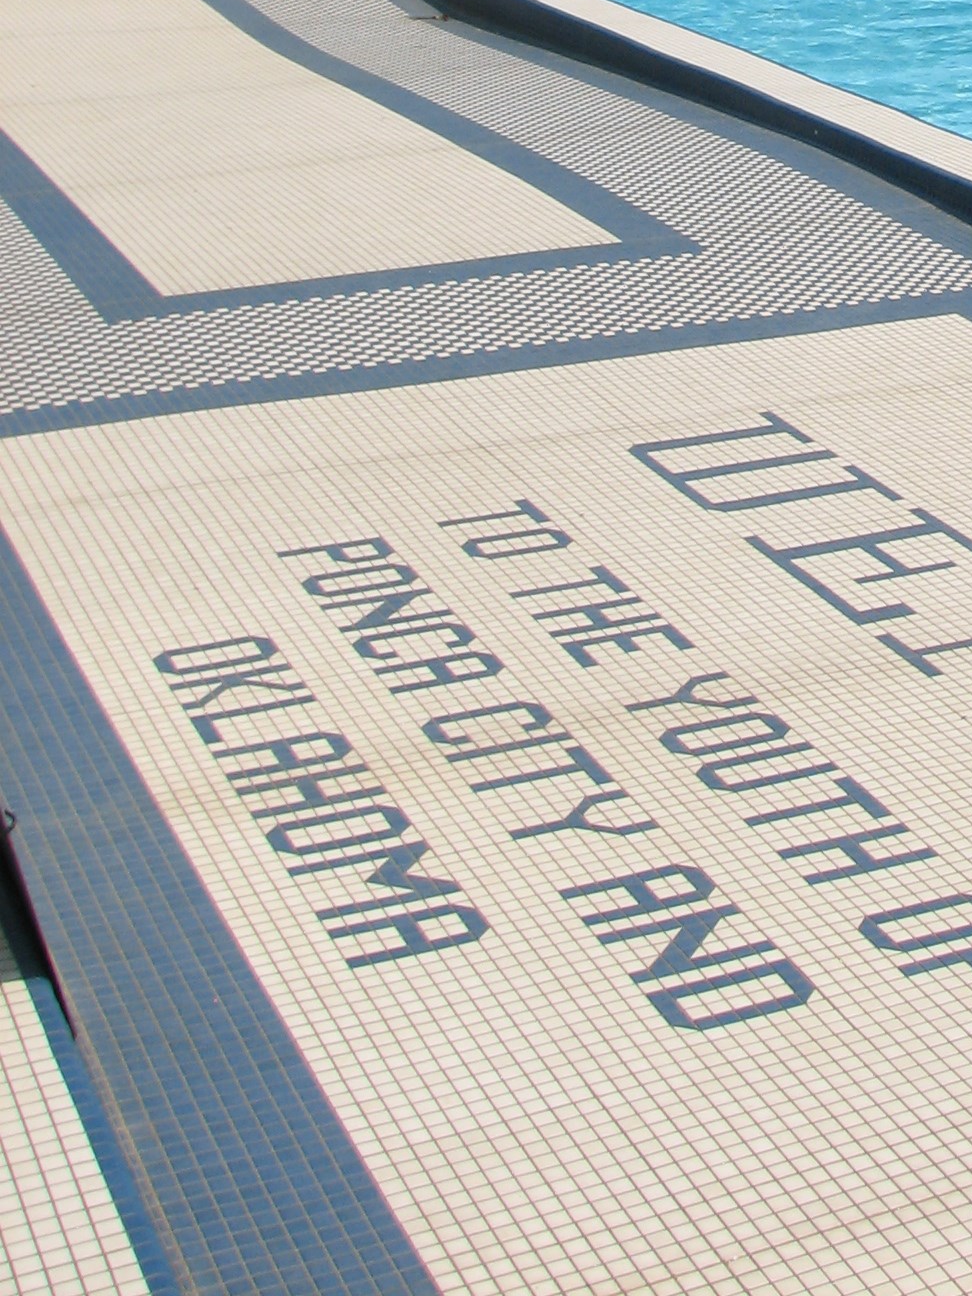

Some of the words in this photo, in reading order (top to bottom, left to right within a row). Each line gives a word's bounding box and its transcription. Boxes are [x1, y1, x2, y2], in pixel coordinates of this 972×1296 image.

[152, 635, 491, 970] OKLAHOMA
[277, 535, 505, 695] PONCA
[421, 701, 660, 840] CITY
[558, 864, 815, 1032] AND
[438, 499, 574, 560] TO
[510, 565, 696, 669] THE
[624, 670, 939, 887] YOUTH
